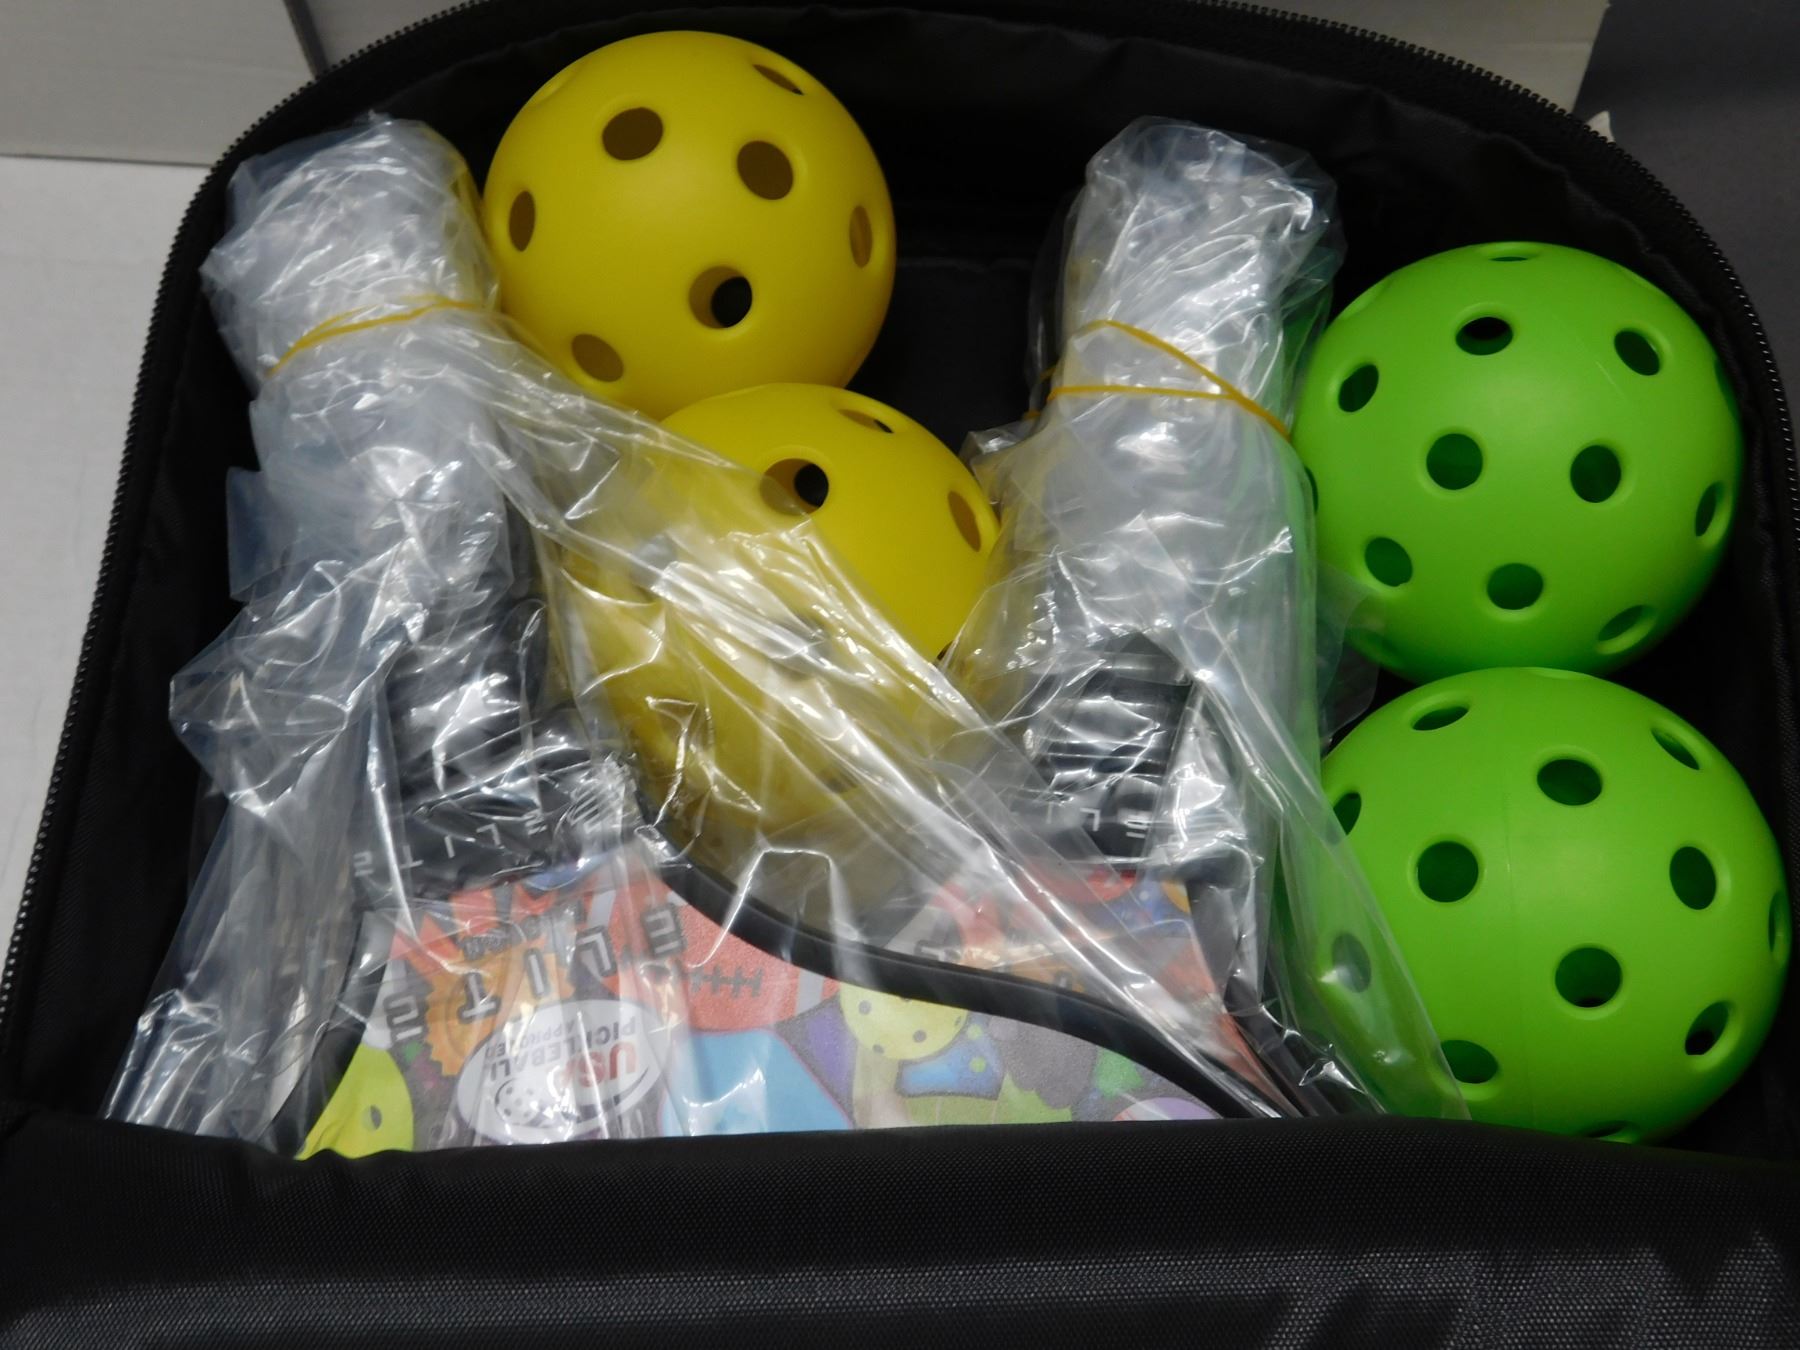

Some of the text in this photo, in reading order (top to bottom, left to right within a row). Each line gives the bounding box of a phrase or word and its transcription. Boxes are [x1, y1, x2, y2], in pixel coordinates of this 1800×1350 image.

[353, 808, 547, 877] ELITE
[382, 904, 685, 1044] ELITE
[484, 1020, 576, 1061] APPROED
